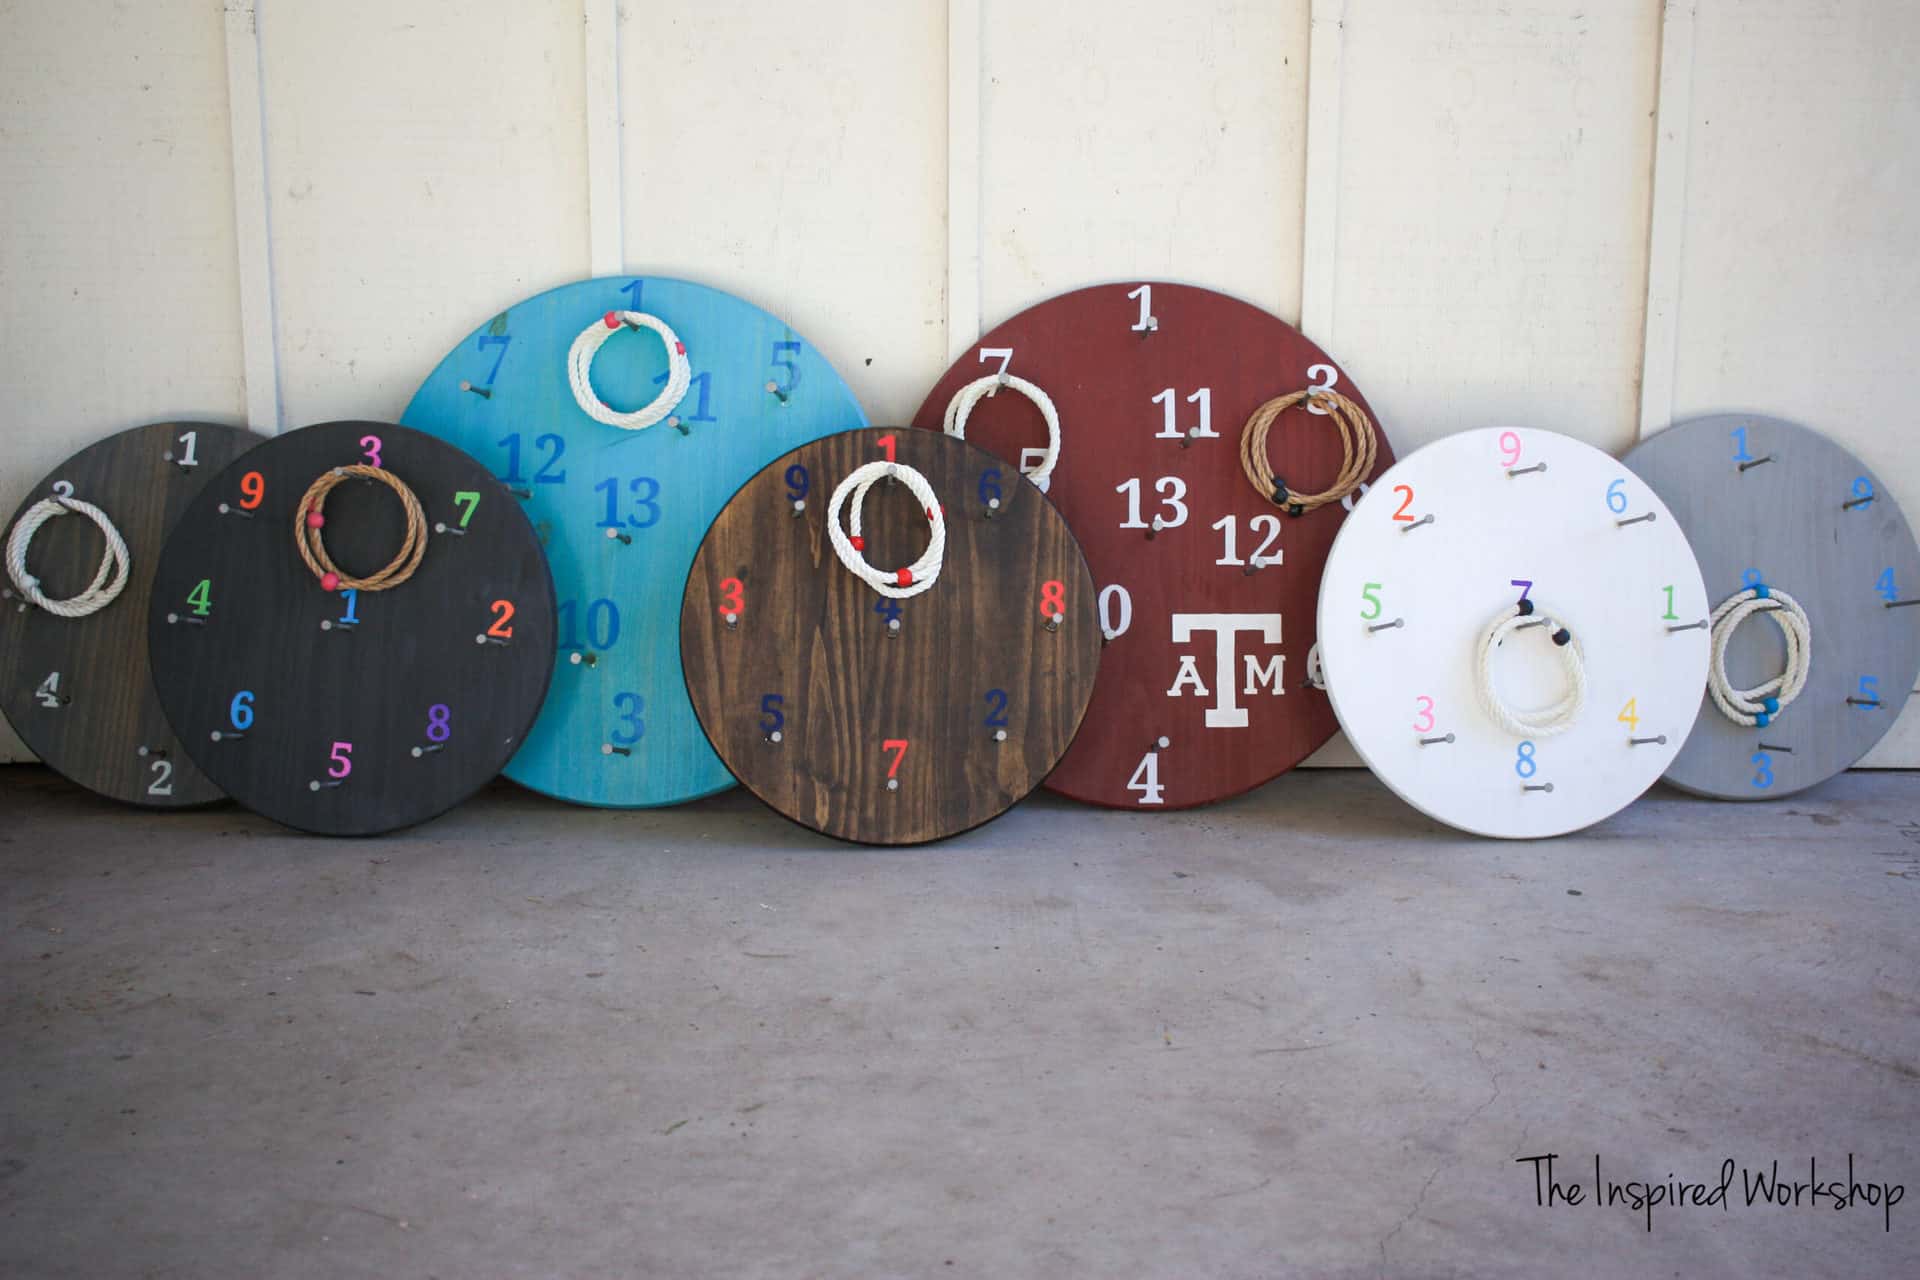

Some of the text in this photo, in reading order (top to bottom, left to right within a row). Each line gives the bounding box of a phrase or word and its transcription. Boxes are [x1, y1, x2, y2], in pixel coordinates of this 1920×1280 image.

[621, 280, 643, 311] 1
[1128, 285, 1158, 331] 1
[478, 336, 512, 385] 7
[770, 341, 801, 392] 5
[979, 347, 1013, 398] 7
[1306, 364, 1338, 415] 3
[1151, 388, 1220, 439] 11
[178, 431, 199, 466] 1
[358, 436, 382, 468] 3
[497, 433, 567, 485] 12
[877, 435, 896, 462] 1
[1500, 432, 1522, 467] 9
[1730, 428, 1753, 461] 1
[240, 472, 265, 509] 9
[784, 464, 809, 502] 9
[978, 468, 1003, 506] 6
[1606, 479, 1628, 513] 6
[454, 492, 480, 528] 7
[595, 477, 662, 529] 13
[1115, 476, 1188, 529] 13
[1392, 485, 1415, 521] 2
[1212, 515, 1283, 566] 12
[186, 579, 212, 615] 4
[719, 577, 744, 617] 3
[1040, 580, 1065, 618] 8
[1360, 583, 1383, 620] 5
[1511, 579, 1533, 600] 7
[1662, 586, 1678, 620] 1
[1875, 567, 1900, 602] 4
[340, 589, 360, 624] 1
[487, 600, 513, 638] 2
[557, 598, 620, 650] 10
[873, 596, 904, 625] 4
[35, 671, 61, 708] 4
[984, 689, 1009, 726] 2
[1859, 675, 1880, 711] 5
[230, 691, 254, 729] 6
[427, 704, 450, 741] 8
[611, 692, 645, 744] 3
[758, 694, 785, 732] 5
[1413, 695, 1435, 732] 3
[1617, 696, 1639, 731] 4
[328, 742, 353, 778] 5
[882, 739, 908, 778] 7
[1516, 740, 1537, 778] 8
[1751, 752, 1774, 789] 3
[147, 760, 173, 796] 2
[1126, 753, 1165, 804] 4
